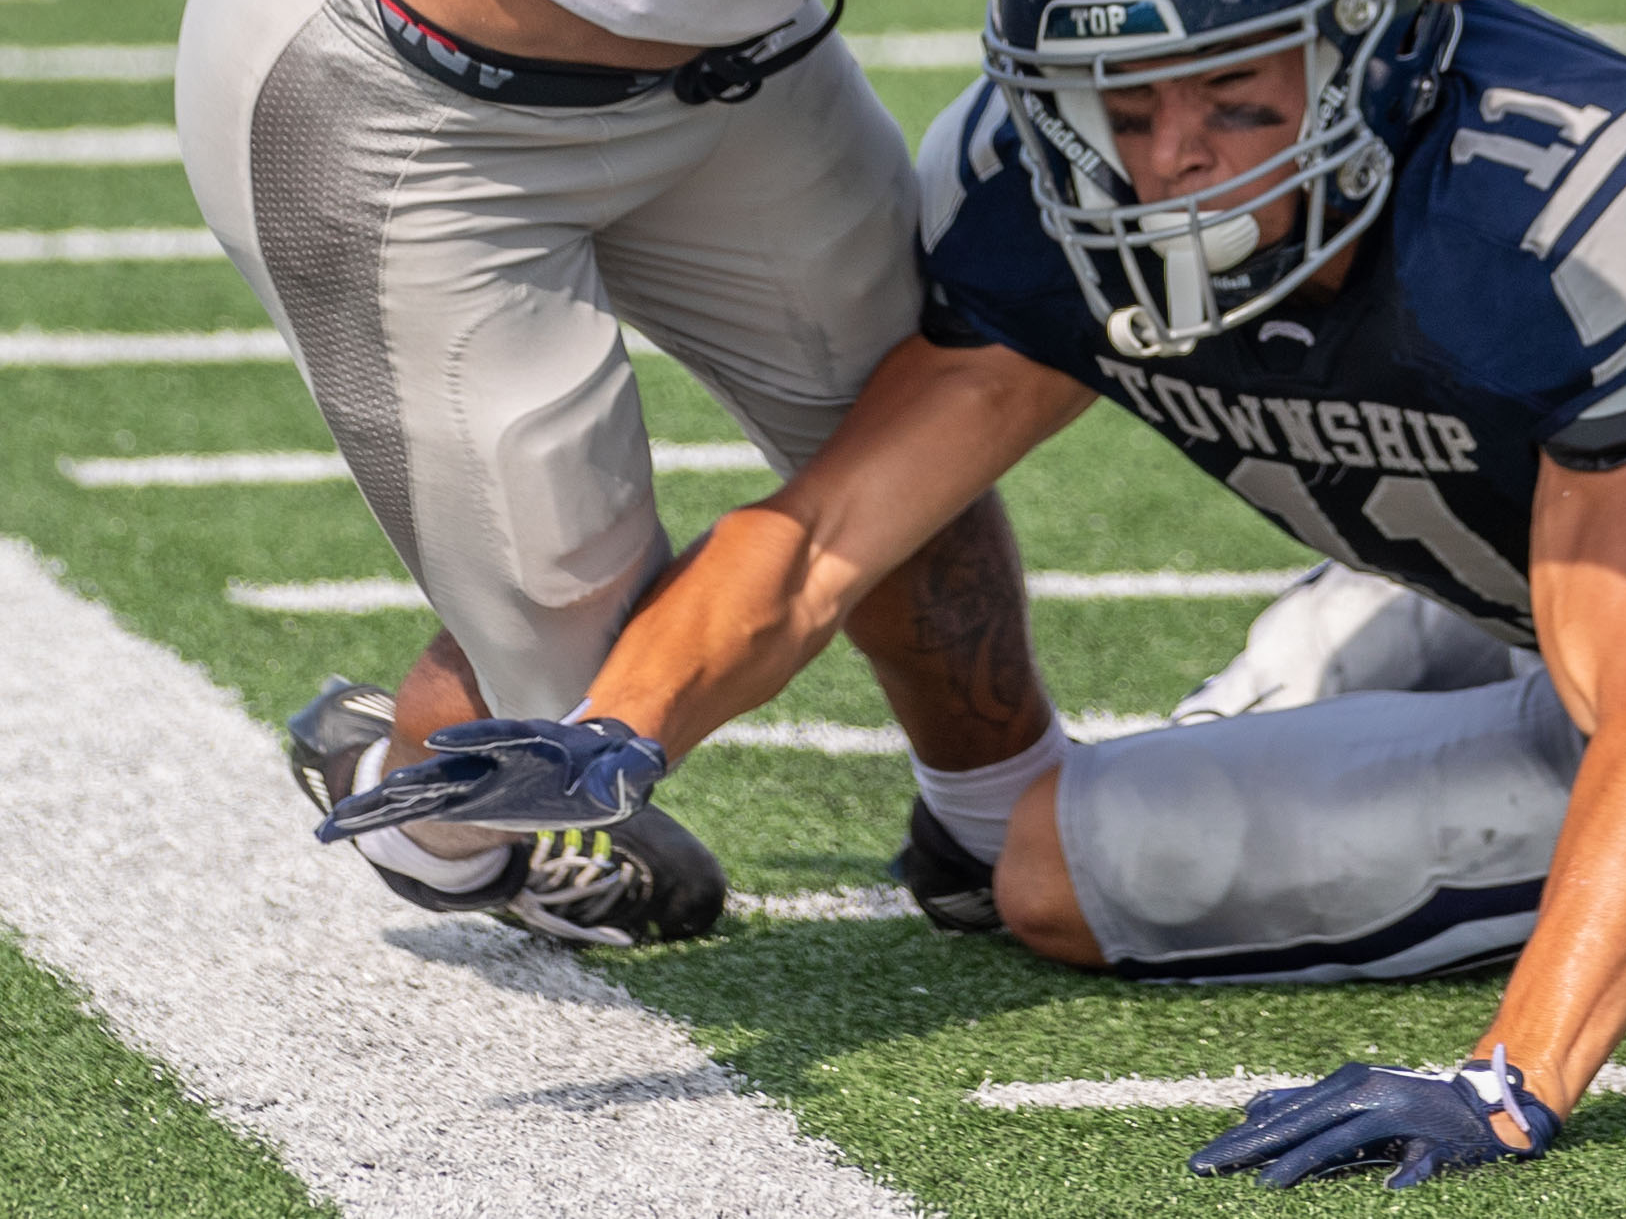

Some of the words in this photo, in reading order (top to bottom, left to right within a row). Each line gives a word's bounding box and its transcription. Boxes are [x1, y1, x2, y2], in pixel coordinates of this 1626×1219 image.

[1070, 4, 1128, 37] TOP
[1450, 87, 1613, 192] 11
[1095, 355, 1479, 474] TOWNSHIP
